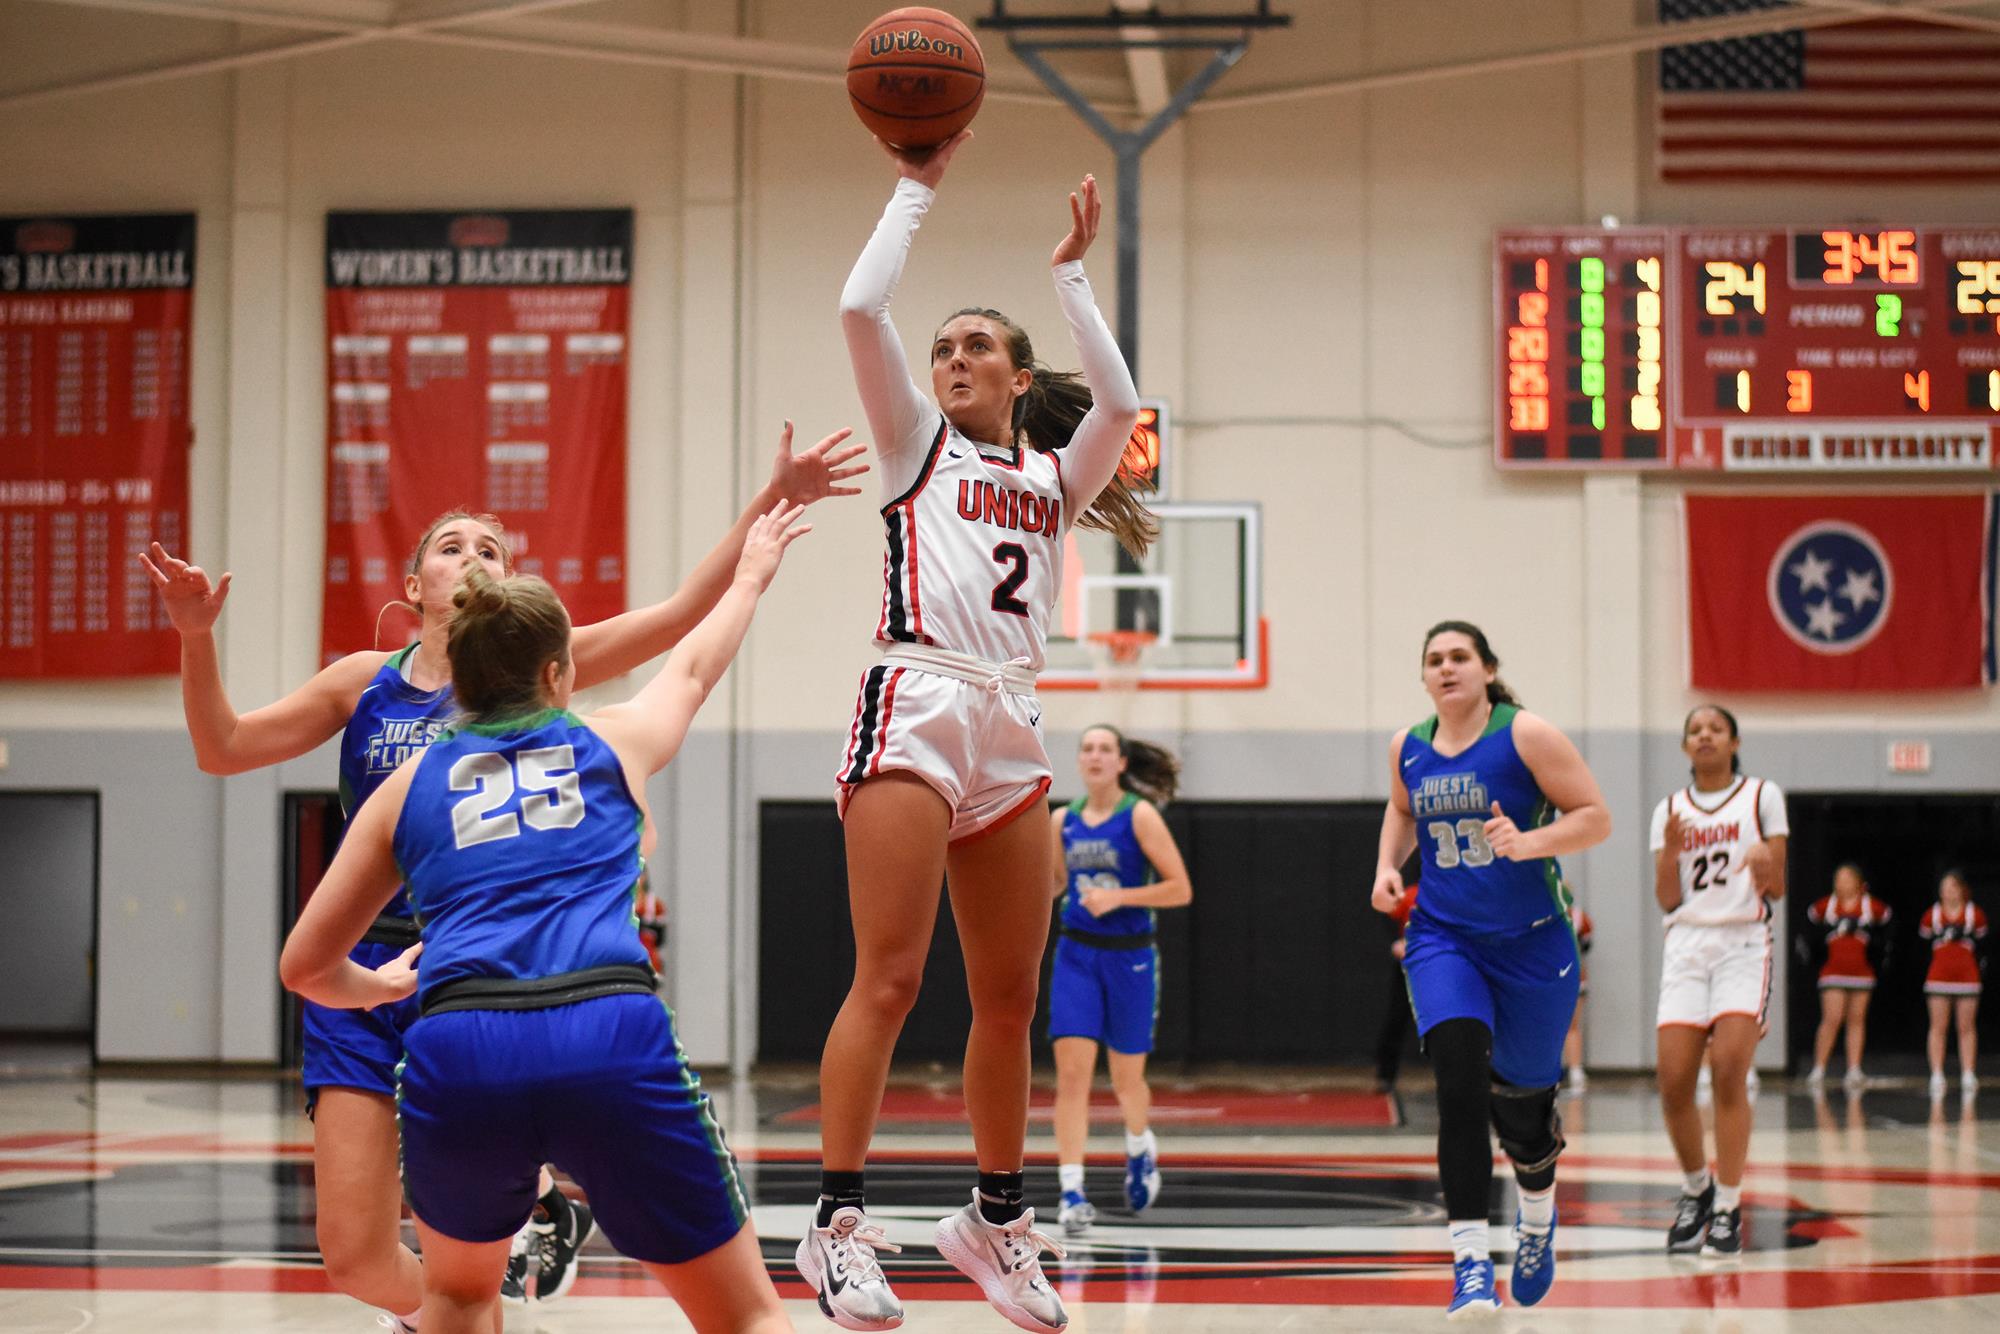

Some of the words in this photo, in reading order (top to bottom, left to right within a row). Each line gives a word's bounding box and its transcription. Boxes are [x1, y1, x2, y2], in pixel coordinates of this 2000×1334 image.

[869, 29, 964, 60] Wilson
[26, 250, 188, 290] BASKETBALL
[331, 250, 454, 286] WOMEN'S
[458, 246, 627, 285] BASKETBALL
[1535, 258, 1548, 292] 1
[1822, 231, 1919, 284] 3:45
[1705, 261, 1766, 315] 24
[1875, 294, 1902, 337] 2
[1737, 370, 1750, 412] 1
[1786, 370, 1812, 412] 3
[1904, 369, 1929, 412] 4
[1592, 396, 1605, 430] 1
[957, 479, 1060, 541] UNION
[991, 540, 1030, 618] 2
[384, 721, 448, 745] WES
[449, 744, 586, 850] 25
[1414, 787, 1485, 815] FLORIDA
[1423, 775, 1473, 798] WEST
[1428, 818, 1494, 868] 33
[1693, 851, 1730, 891] 22
